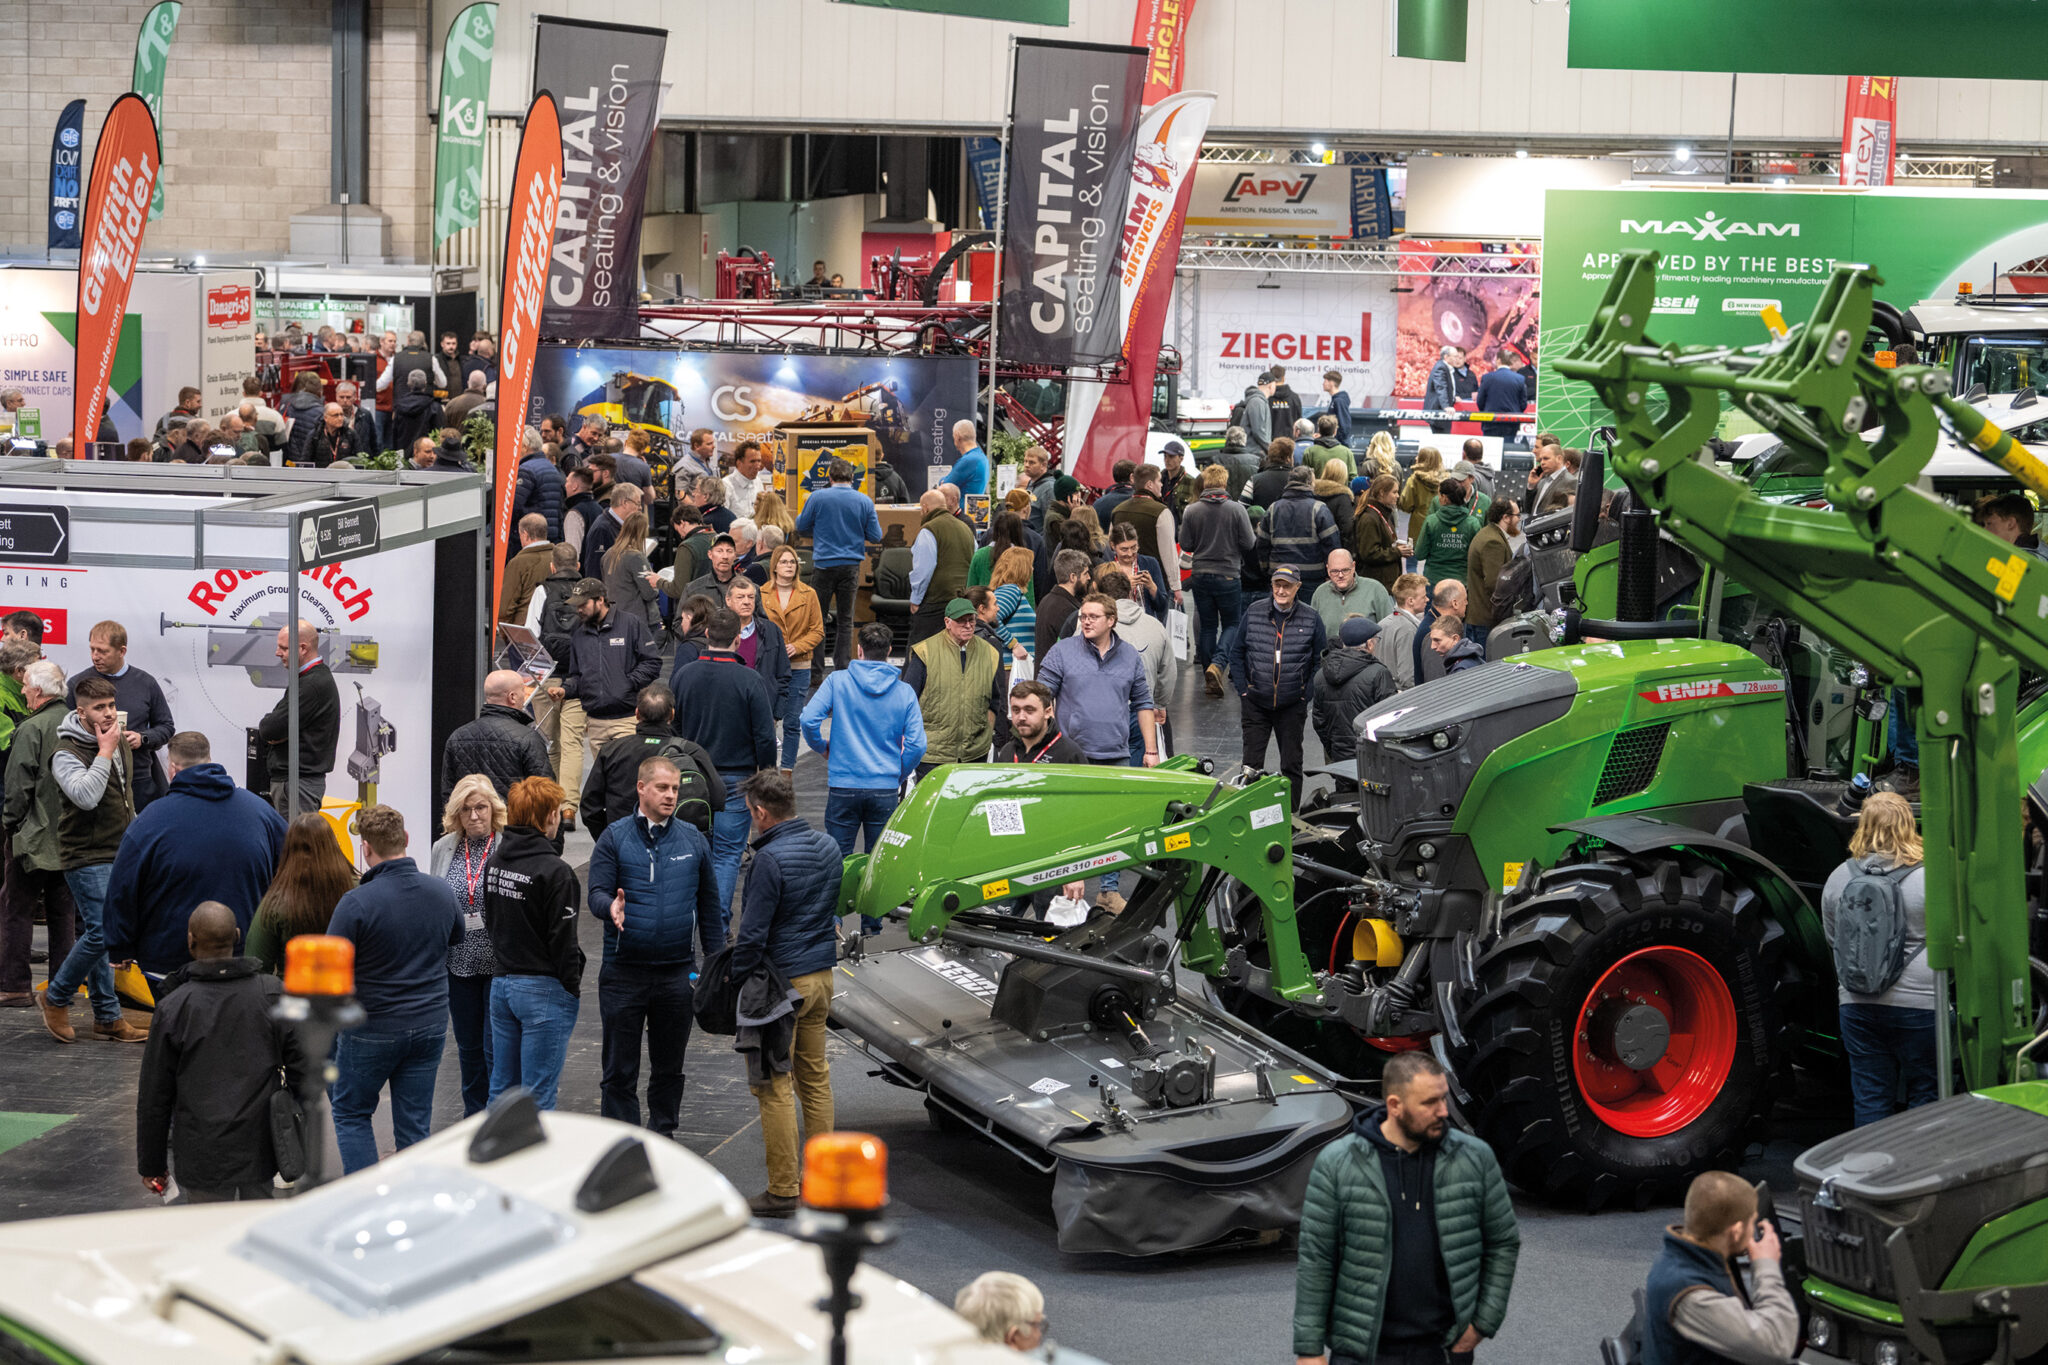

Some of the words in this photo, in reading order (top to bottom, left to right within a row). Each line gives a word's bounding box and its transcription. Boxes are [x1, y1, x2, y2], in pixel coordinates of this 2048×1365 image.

[1151, 0, 1160, 22] worl
[1152, 0, 1180, 87] ZIEGLE
[442, 95, 485, 137] K&J
[601, 63, 630, 151] vision
[1082, 84, 1110, 174] vision
[597, 160, 622, 183] &
[54, 177, 79, 198] NO
[550, 87, 599, 307] CAPITAL
[1079, 183, 1103, 207] &
[1236, 179, 1304, 197] APV
[111, 152, 153, 283] Elder
[1030, 109, 1079, 334] CAPITAL
[1620, 211, 1800, 241] MAXAM
[84, 156, 133, 316] Griffith
[525, 162, 558, 329] Elder
[1123, 199, 1163, 287] sprayers
[593, 194, 623, 307] seating
[1582, 253, 1696, 271] APPVED
[1704, 256, 1730, 272] BY
[1738, 256, 1777, 273] THE
[1787, 258, 1835, 274] BEST
[503, 171, 545, 380] Griffith
[1074, 217, 1105, 333] seating
[1582, 272, 1613, 281] Approv
[1692, 275, 1701, 284] by
[1702, 275, 1731, 285] leading
[1733, 276, 1773, 286] machinery
[1776, 277, 1831, 286] manufacturer
[209, 296, 249, 318] Danagri-3S
[256, 300, 273, 309] ING
[279, 301, 314, 310] SPARES
[318, 302, 326, 311] &
[327, 302, 366, 312] REPAIRS
[1651, 298, 1683, 308] ASE
[1220, 332, 1354, 361] ZIEGLER
[4, 369, 39, 381] SIMPLE
[42, 371, 67, 382] SAFE
[85, 303, 121, 440] griffith-elder.com
[1219, 362, 1266, 372] Harvesting
[1323, 365, 1370, 374] Cultivation
[52, 386, 71, 396] CAPS
[711, 385, 757, 422] CS
[501, 358, 532, 543] griffith-elder.com
[675, 430, 773, 443] CATALseat
[933, 408, 947, 465] seating
[344, 515, 359, 528] Bennett
[338, 532, 361, 548] Engineering
[229, 589, 266, 621] Maximum
[267, 585, 300, 594] Grou
[301, 590, 335, 626] Clearance
[1656, 679, 1722, 700] FENDT
[1742, 682, 1759, 692] 728
[1760, 683, 1778, 691] VARIO
[499, 869, 533, 885] FARMERS.
[1032, 866, 1070, 882] SLICER
[1072, 860, 1091, 872] 310
[1106, 855, 1118, 863] KC
[498, 878, 517, 889] FOOD.
